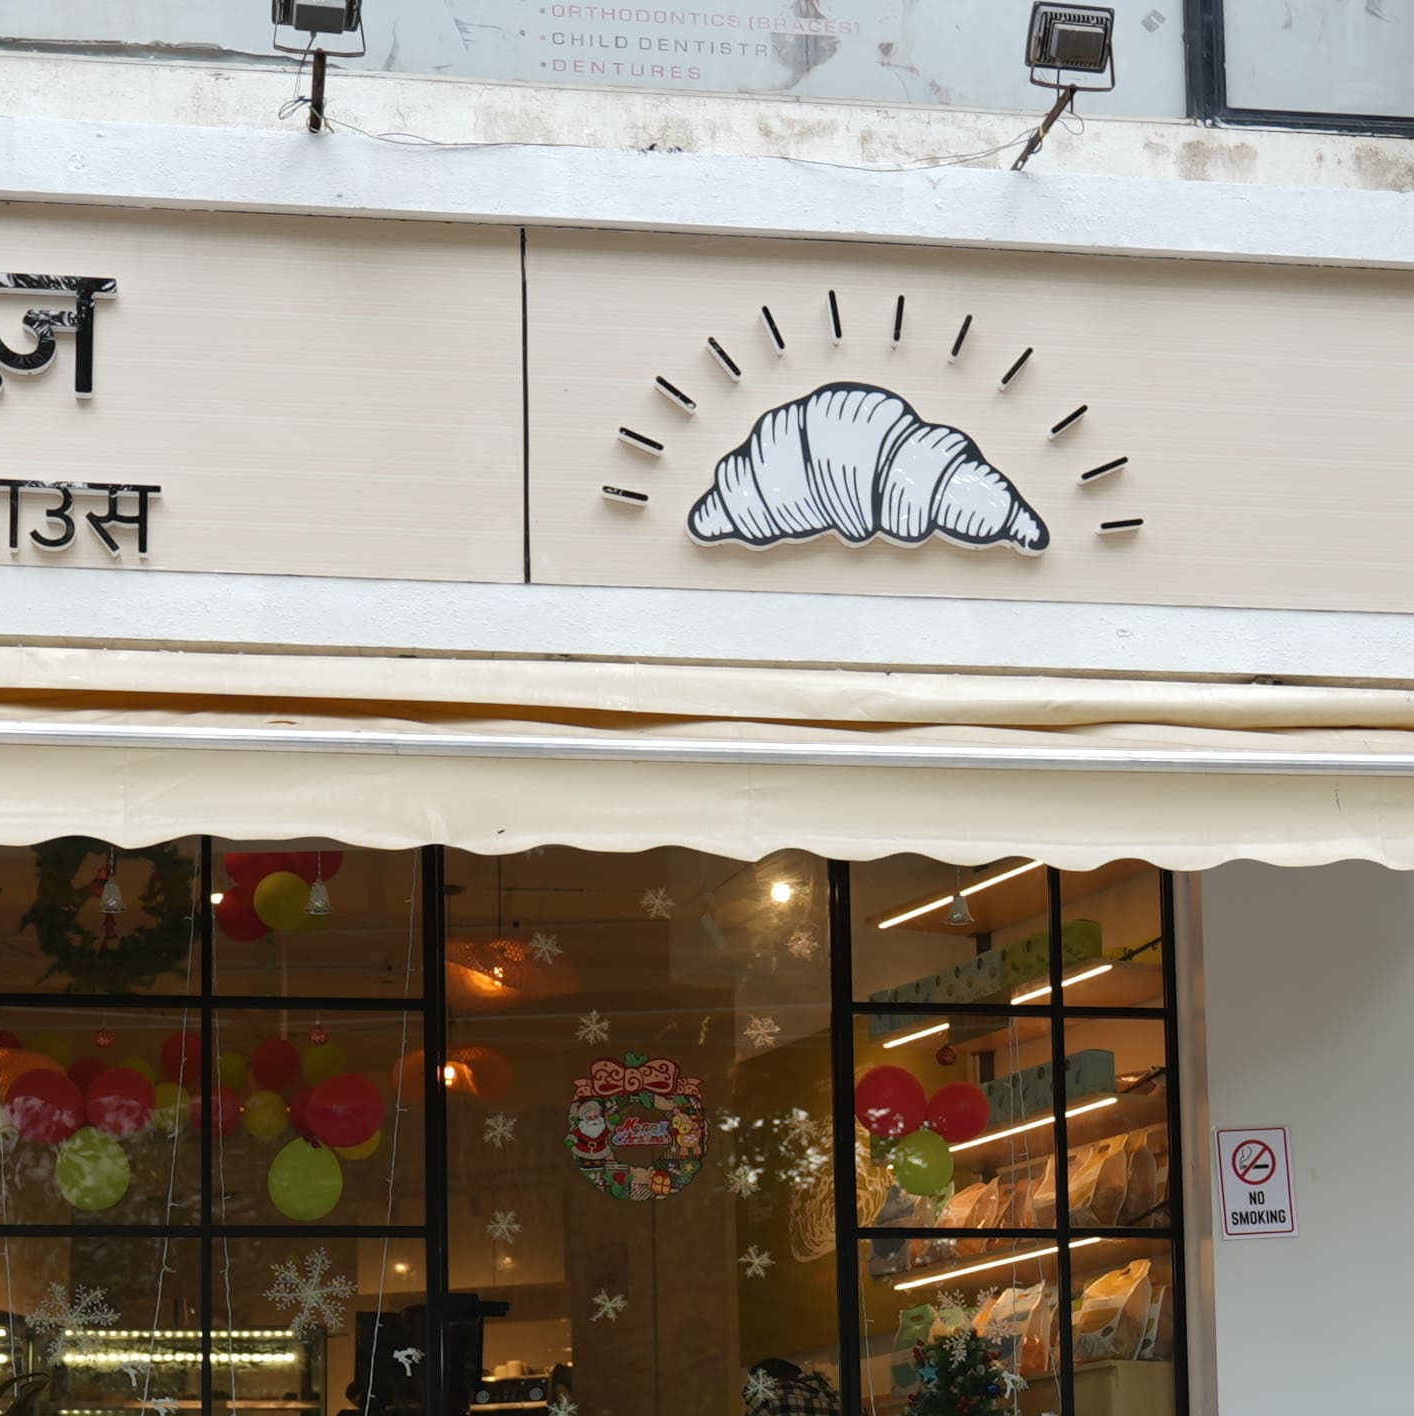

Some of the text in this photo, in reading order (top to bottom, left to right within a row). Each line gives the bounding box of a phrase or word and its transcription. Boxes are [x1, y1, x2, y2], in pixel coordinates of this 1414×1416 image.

[551, 4, 861, 36] ORTHODONTICS (BRACES)
[552, 32, 629, 50] CHILD
[552, 58, 703, 80] DENTURES
[1248, 1191, 1265, 1206] NO
[1231, 1209, 1287, 1226] SMOKING
